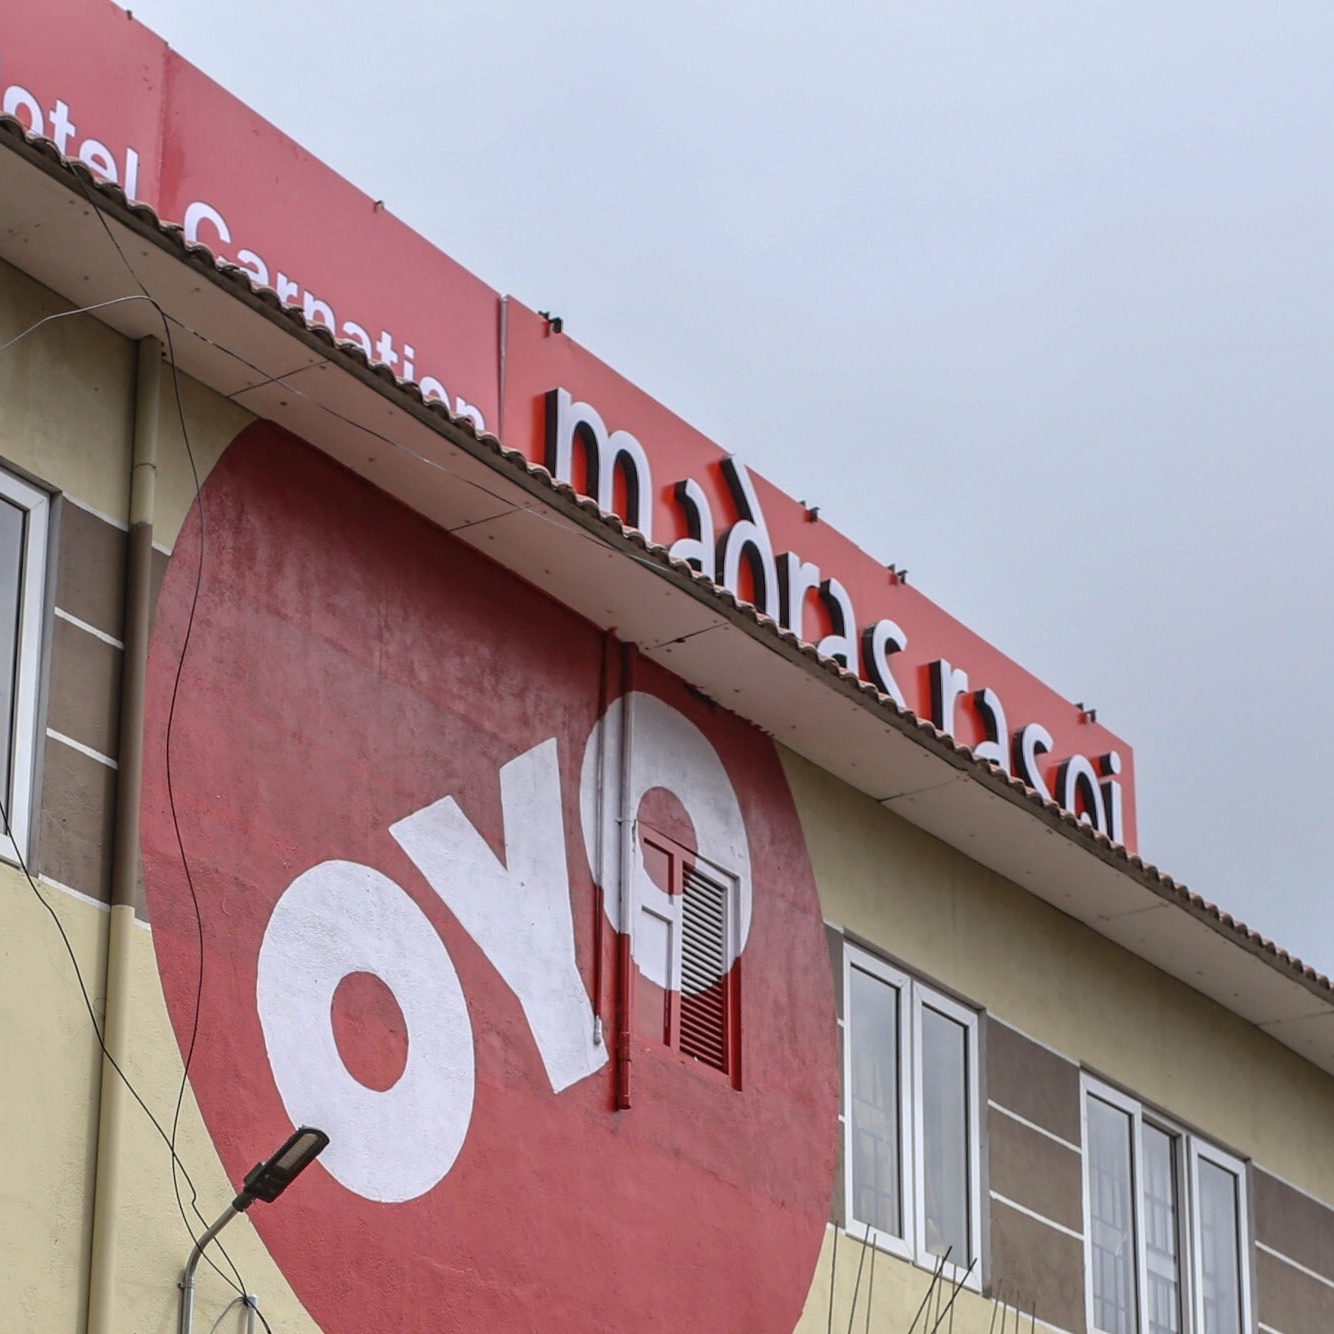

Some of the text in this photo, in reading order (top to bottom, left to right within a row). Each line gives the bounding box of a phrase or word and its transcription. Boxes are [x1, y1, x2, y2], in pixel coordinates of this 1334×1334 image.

[548, 387, 1125, 845] madras rasoi
[257, 691, 753, 1203] OYO
